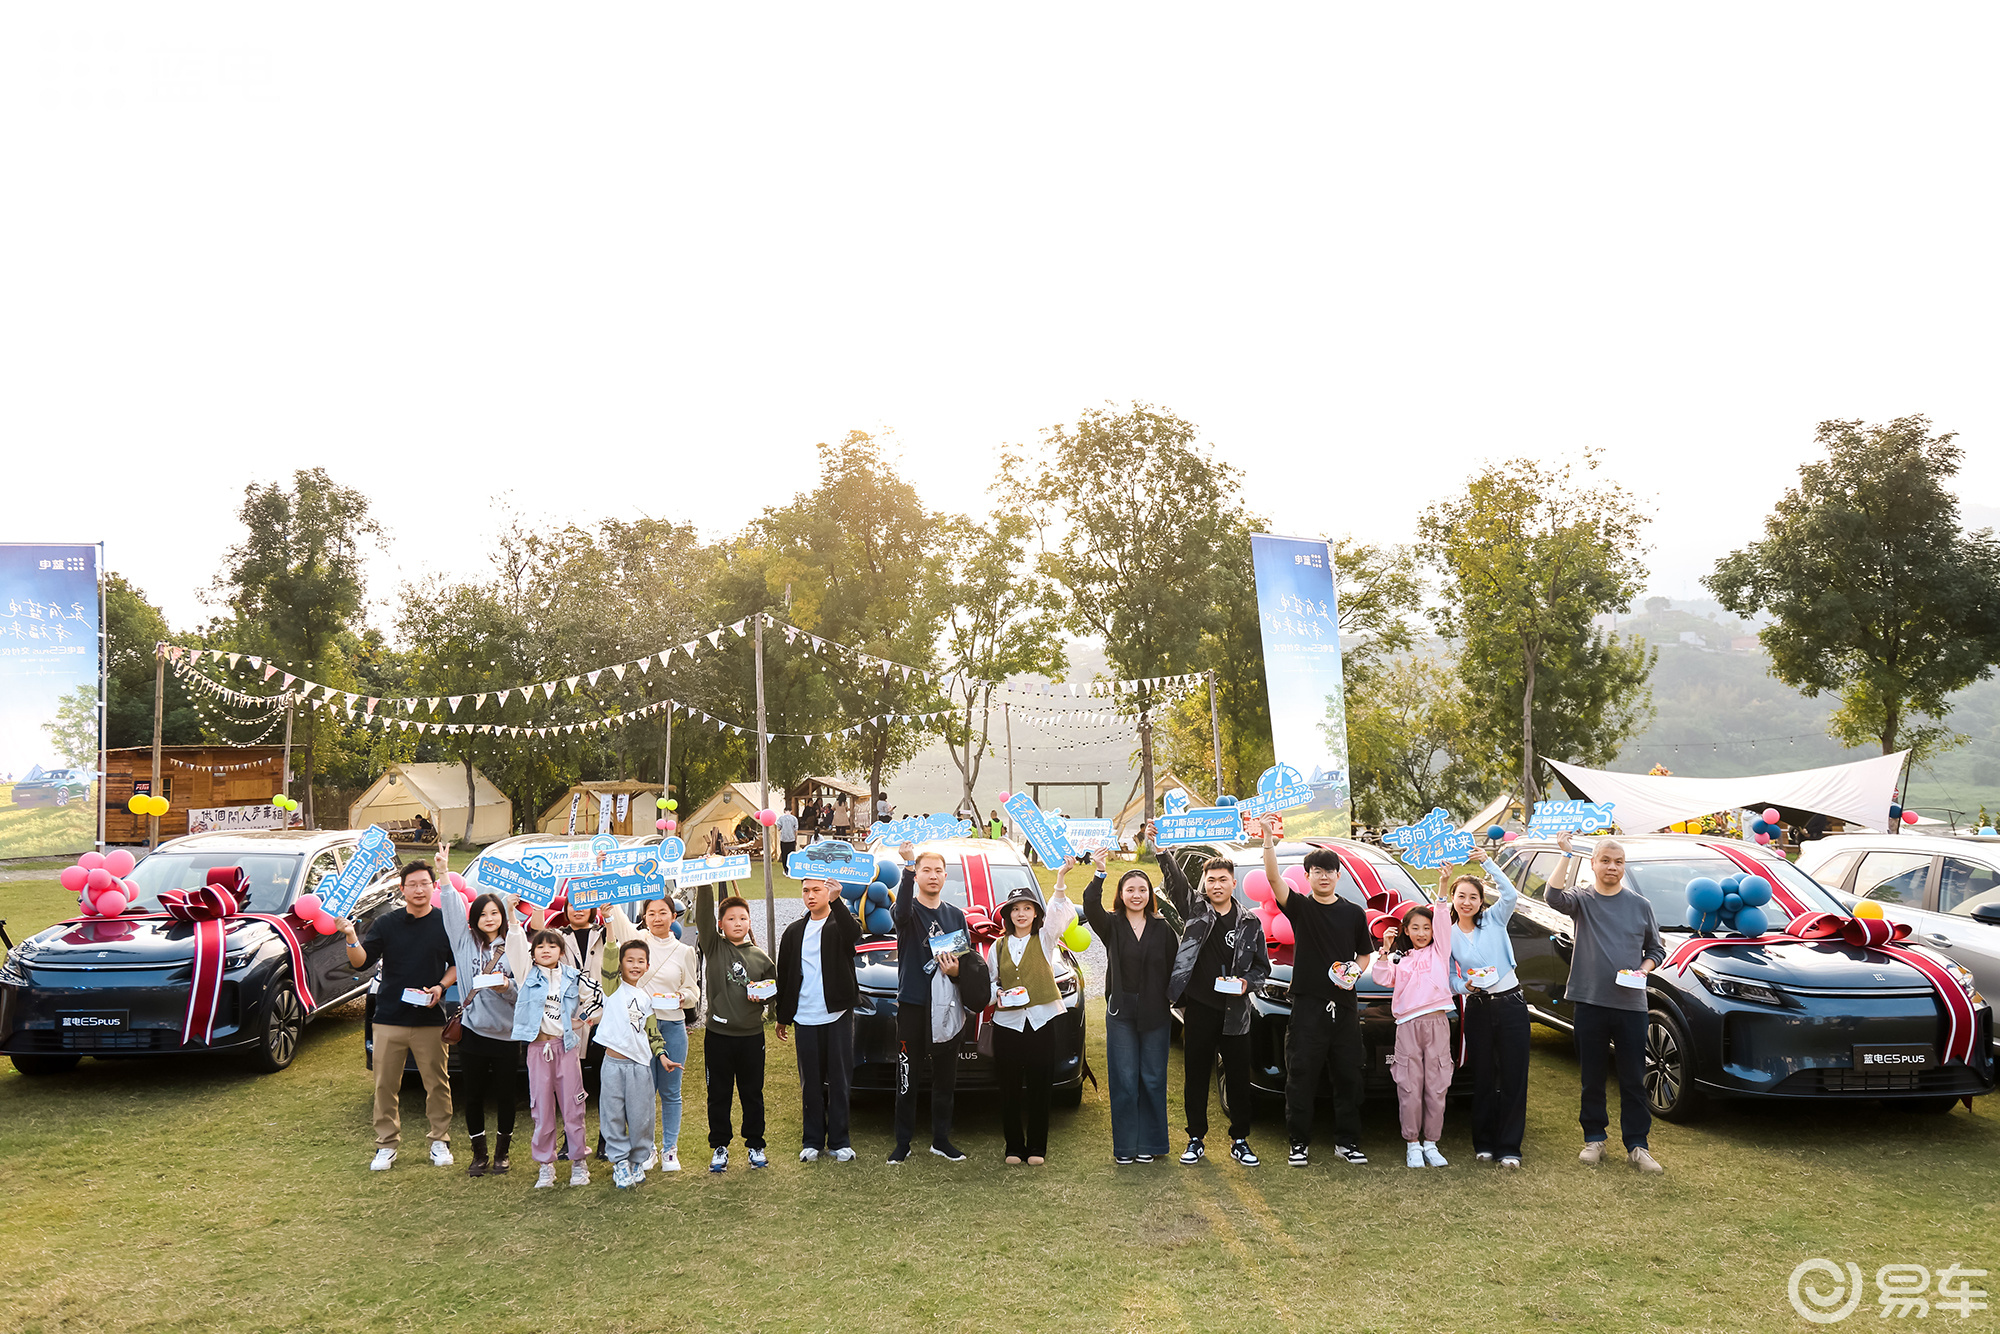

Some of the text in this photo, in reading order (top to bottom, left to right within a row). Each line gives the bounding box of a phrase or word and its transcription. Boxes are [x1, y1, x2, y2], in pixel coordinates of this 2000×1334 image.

[1252, 793, 1312, 817] 生活向前冲
[1535, 801, 1585, 815] 1694L
[1161, 817, 1204, 828] 赛力斯品控
[1385, 811, 1451, 845] 一路向蓝
[1405, 835, 1471, 865] 幸福快来
